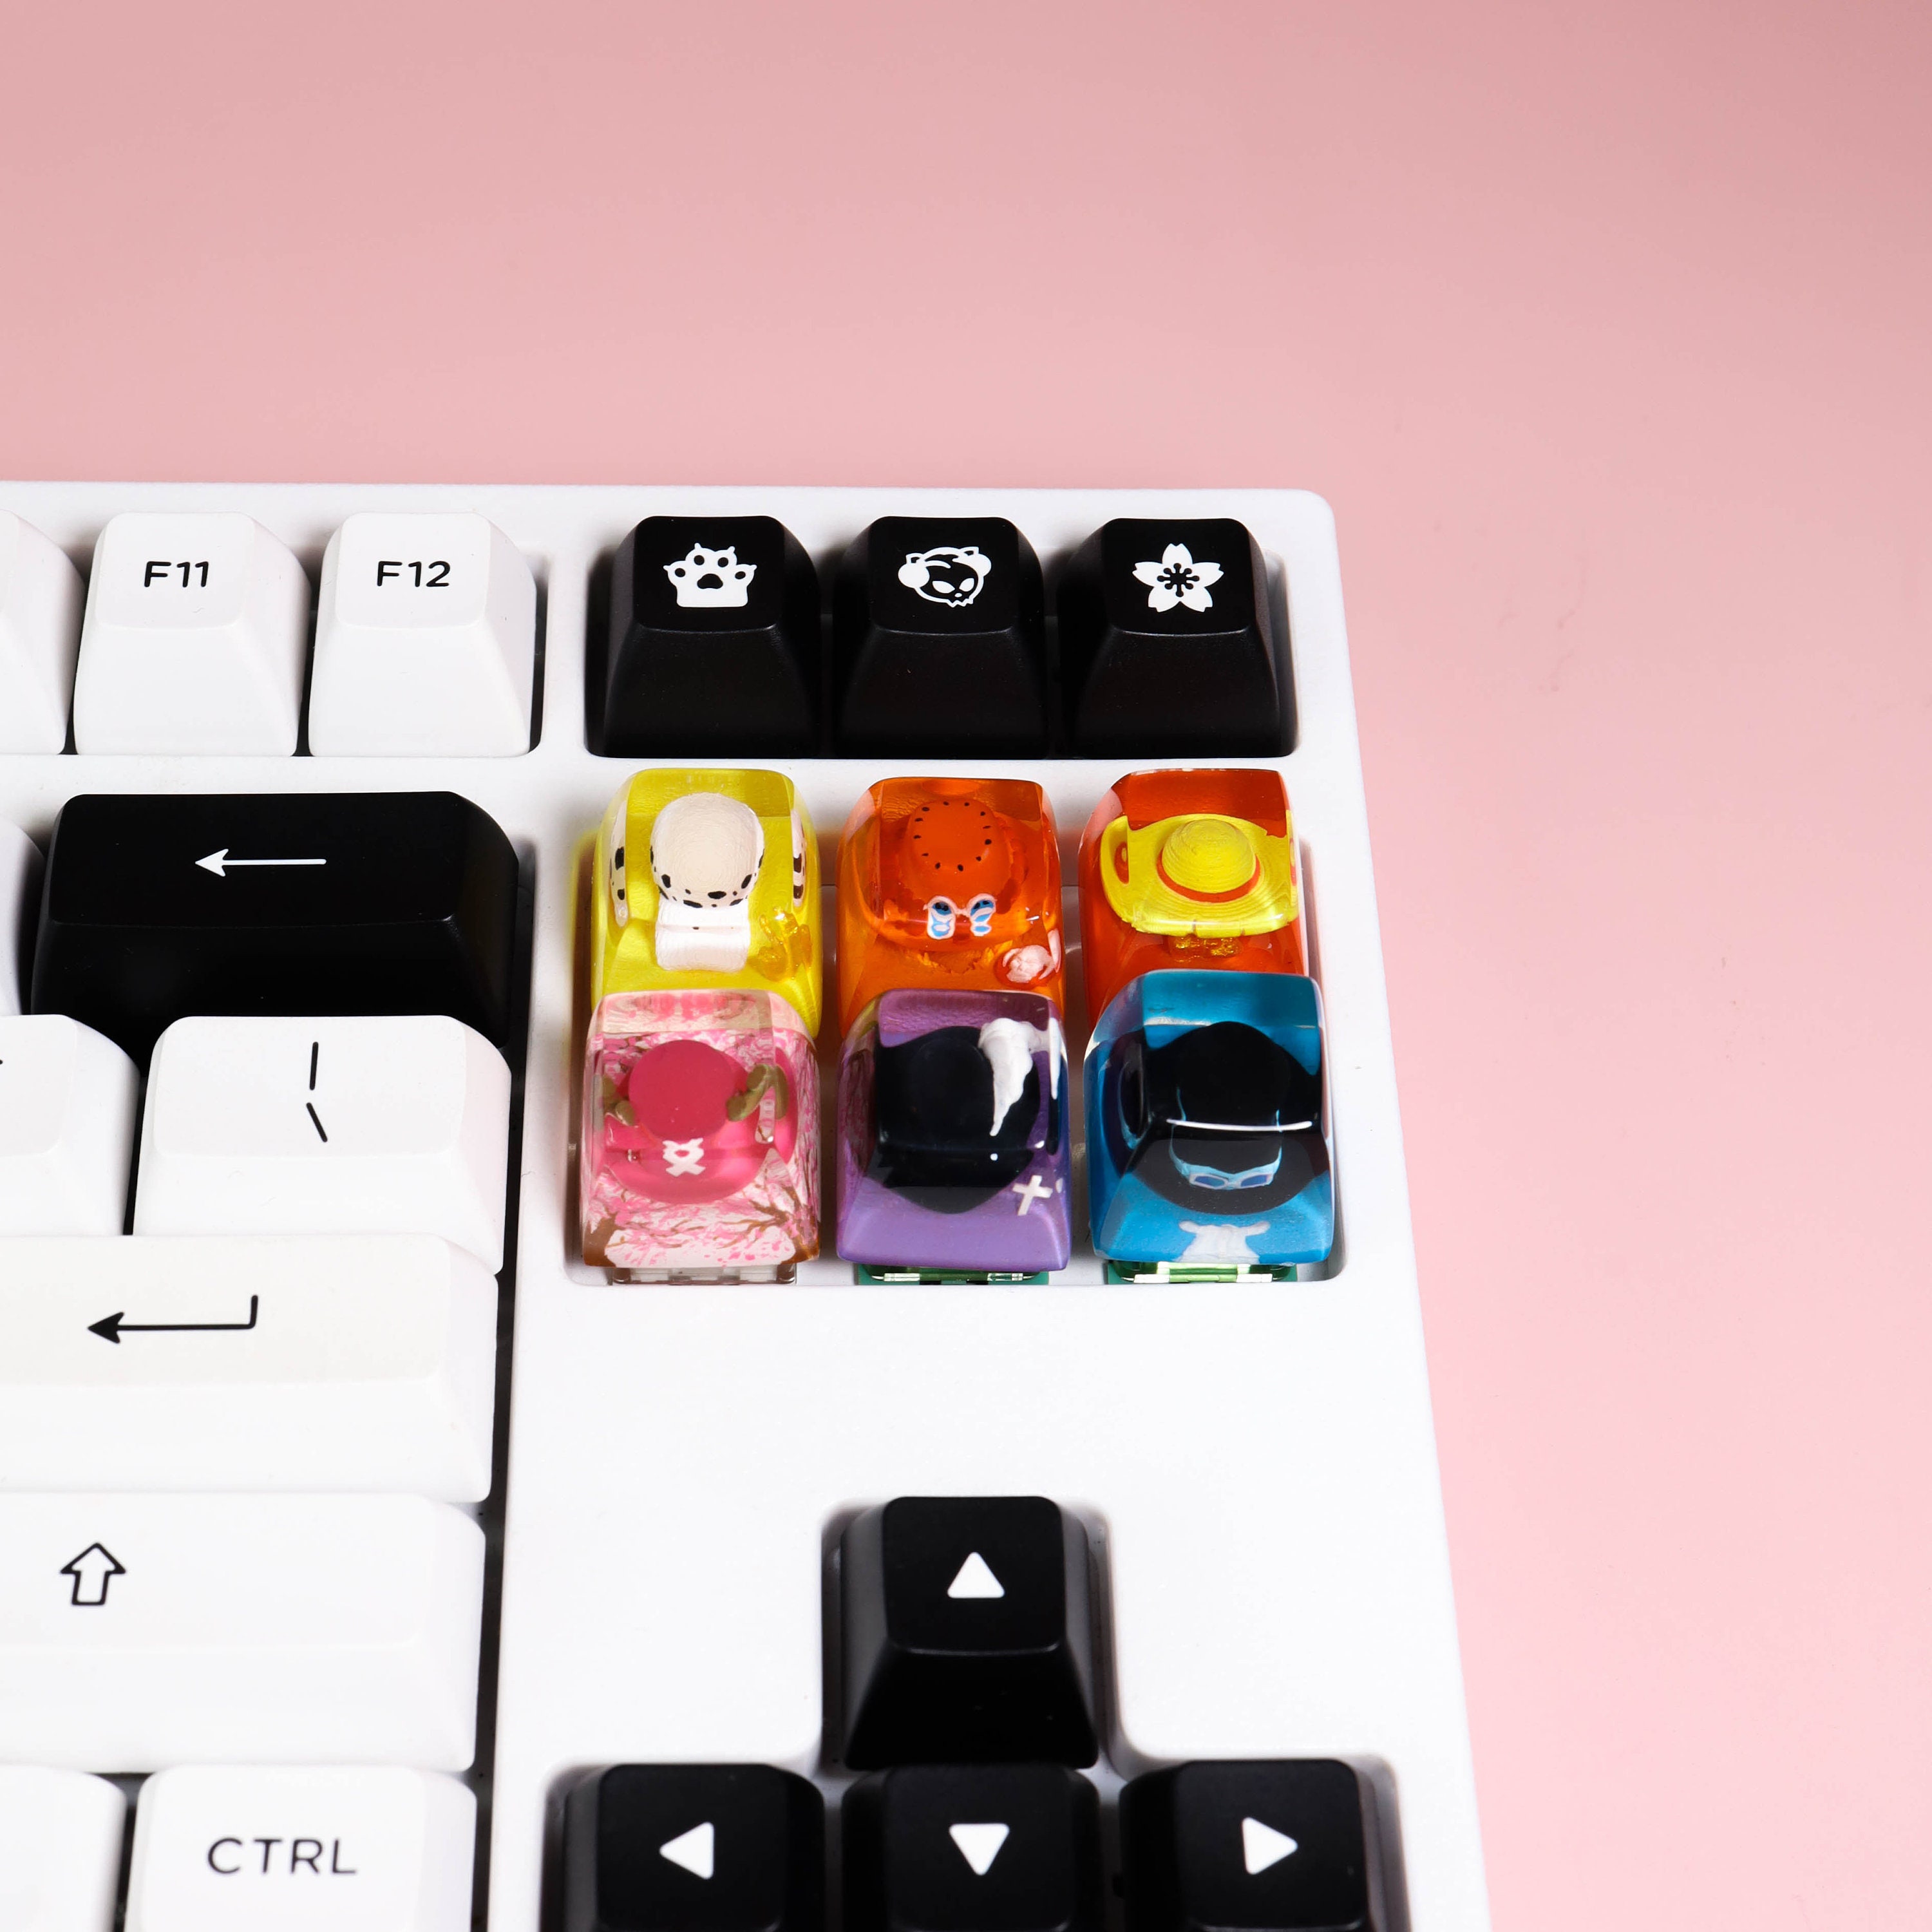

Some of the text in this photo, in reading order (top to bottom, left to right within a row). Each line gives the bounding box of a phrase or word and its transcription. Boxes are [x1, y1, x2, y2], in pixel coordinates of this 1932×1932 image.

[144, 561, 210, 588] F11
[377, 560, 451, 588] F12
[207, 1837, 357, 1875] CTRL
